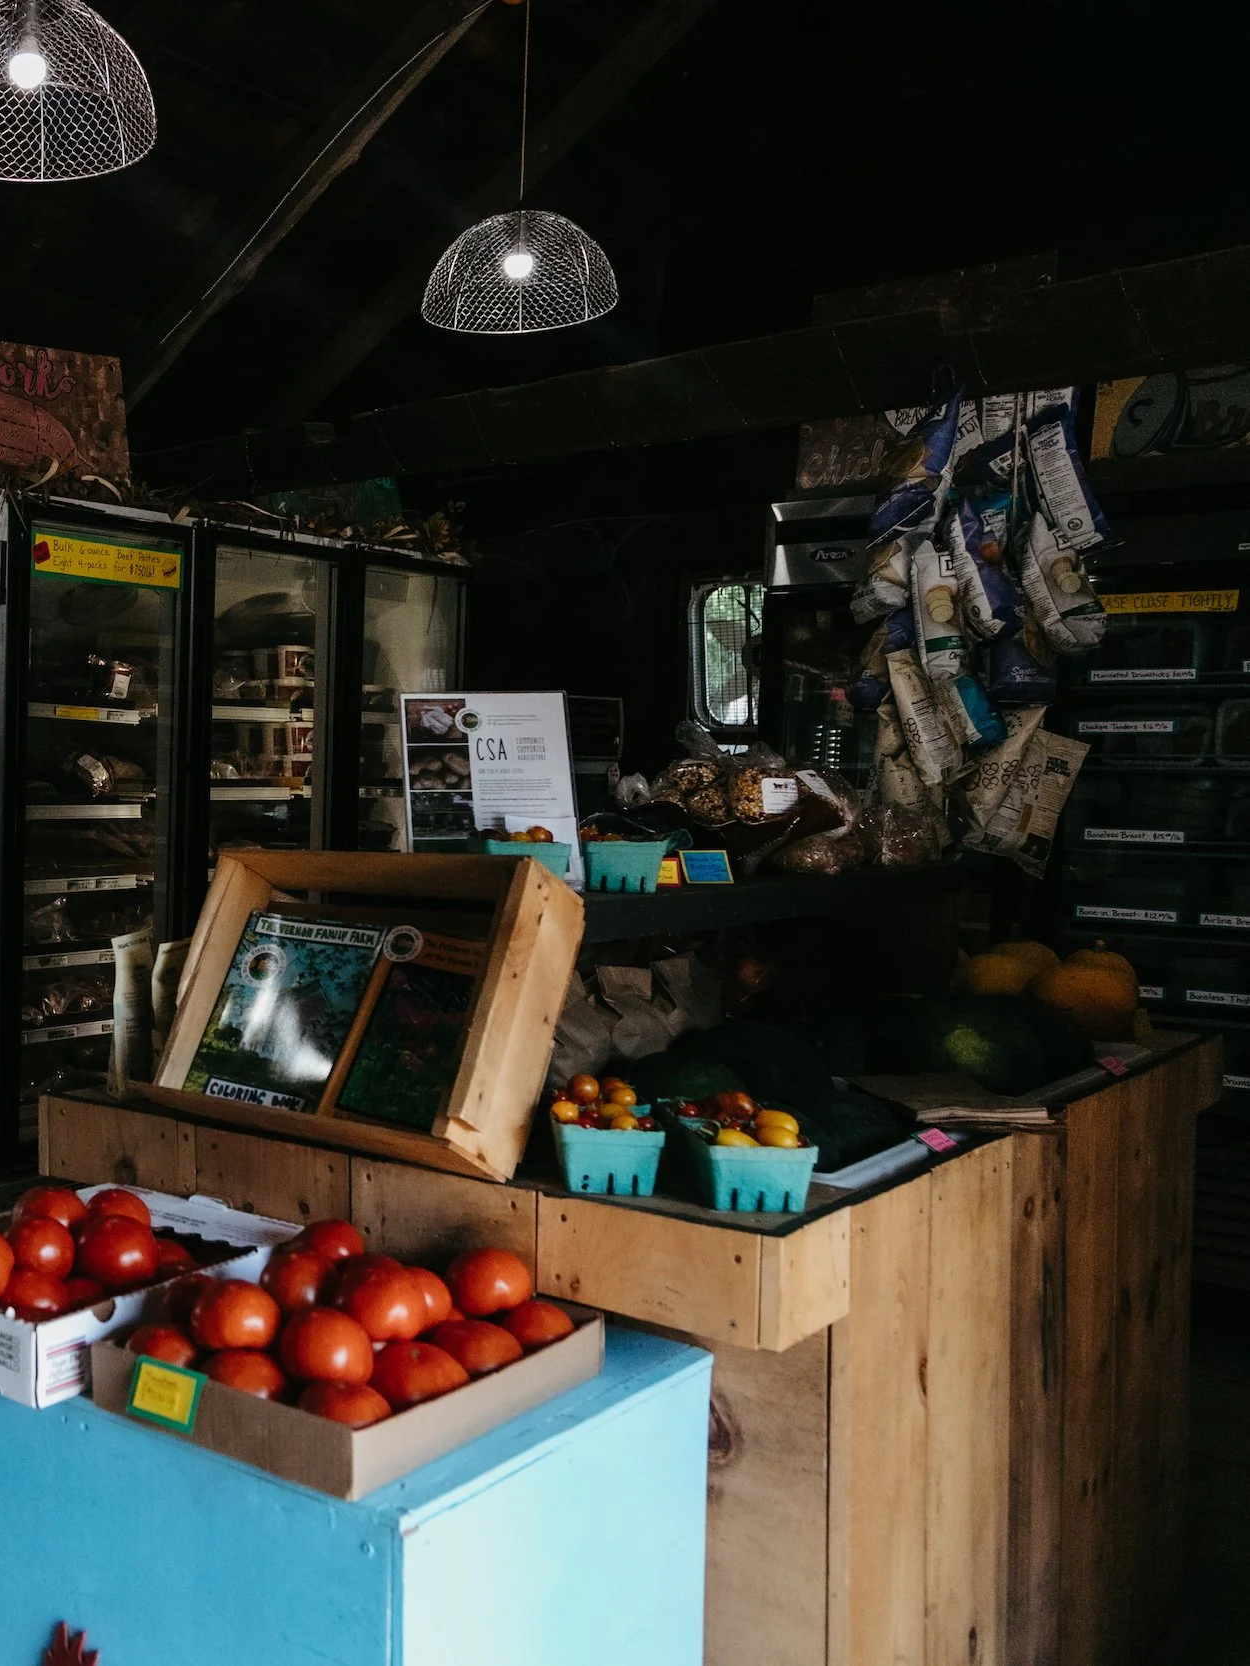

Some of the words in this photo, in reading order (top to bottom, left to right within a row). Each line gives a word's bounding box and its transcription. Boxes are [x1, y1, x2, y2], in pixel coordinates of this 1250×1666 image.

[800, 439, 887, 489] Chick
[53, 539, 74, 553] Bulk
[79, 544, 111, 557] 6-ounce
[117, 548, 134, 561] Beef
[138, 551, 161, 564] Patties
[53, 555, 74, 571] Eight
[78, 560, 107, 572] 4-packs
[113, 562, 127, 573] for
[1102, 596, 1128, 609] ASE
[1133, 595, 1170, 609] CLOSE
[1177, 593, 1234, 608] TIGHTLY
[1093, 671, 1129, 680] Marinated
[1131, 670, 1170, 679] Drumsticks
[1080, 722, 1109, 731] Chicken
[1112, 722, 1138, 730] Tenders
[515, 737, 545, 745] COMMUNITY
[476, 737, 508, 761] CSA
[516, 745, 546, 753] SUPPORTED
[1086, 830, 1119, 839] Boneless
[1078, 907, 1109, 916] Bone-in
[1112, 910, 1137, 918] Breast
[1202, 916, 1232, 925] Airline
[279, 920, 313, 938] VERNON
[314, 927, 349, 942] FAMILY
[349, 931, 375, 945] FARM
[1189, 991, 1225, 1001] Boneless
[1222, 1076, 1250, 1087] Drums
[209, 1082, 267, 1105] COLORING
[271, 1095, 300, 1111] BOOK
